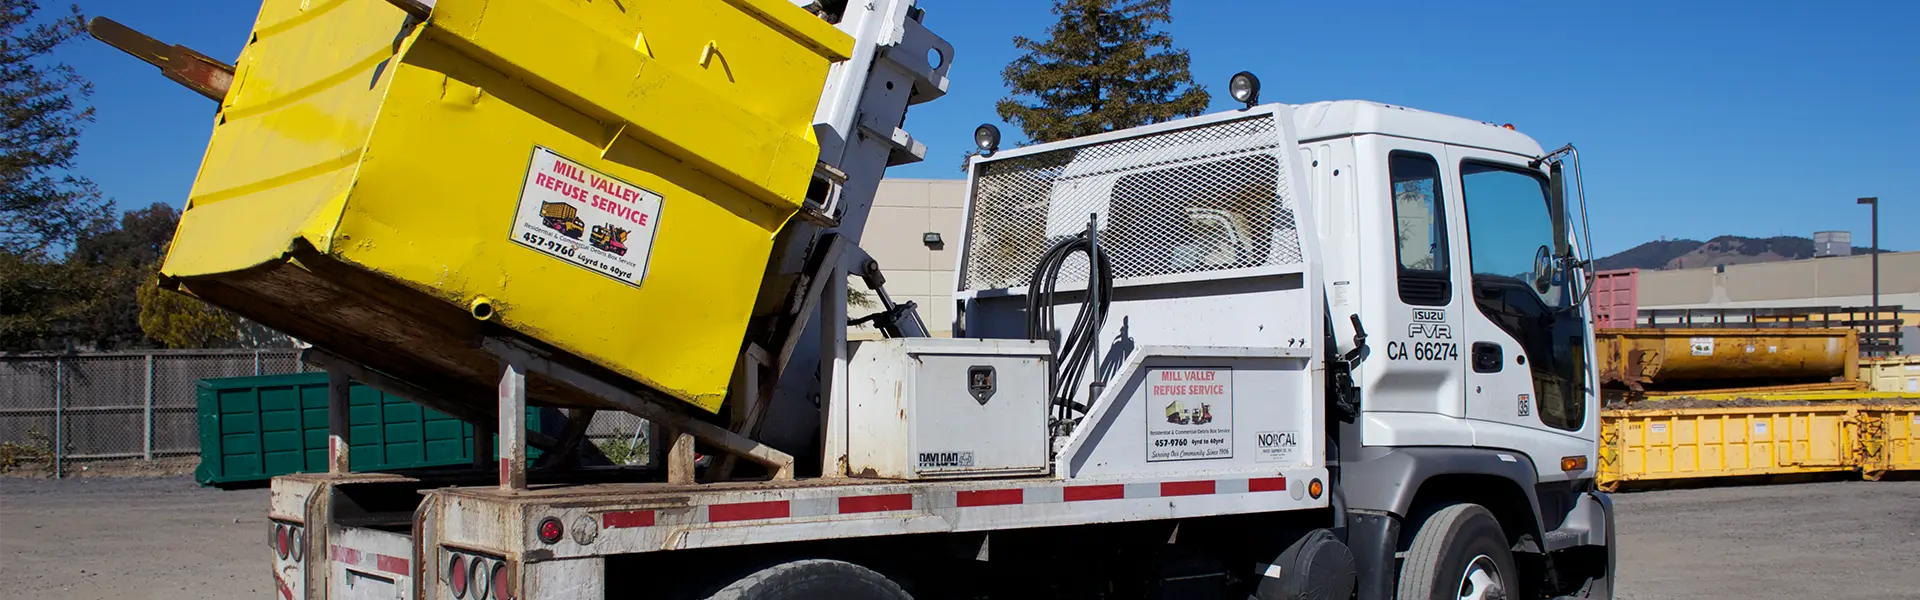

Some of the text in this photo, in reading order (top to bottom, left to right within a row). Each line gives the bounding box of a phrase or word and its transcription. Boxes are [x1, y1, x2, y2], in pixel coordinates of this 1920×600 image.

[553, 160, 641, 204] MILL VALLEY
[535, 172, 648, 227] REFUSE SERVICE
[523, 222, 554, 237] Residential
[560, 235, 590, 251] Commercial
[589, 247, 607, 258] Debris
[607, 252, 618, 261] Box
[618, 256, 637, 268] Service
[523, 232, 575, 258] 457-9760
[600, 260, 608, 270] to
[610, 265, 632, 279] 40yrd
[1414, 311, 1444, 320] ISUZU
[1408, 323, 1452, 339] FVR
[1387, 341, 1458, 361] CA 66274
[1162, 371, 1216, 381] MILL VALLEY
[1153, 385, 1224, 396] REFUSE SERVICE
[1155, 438, 1188, 447] 457-9760
[1258, 433, 1296, 447] NORCAL
[1151, 450, 1170, 459] Serving
[1180, 450, 1205, 458] Community
[1206, 448, 1218, 456] Since
